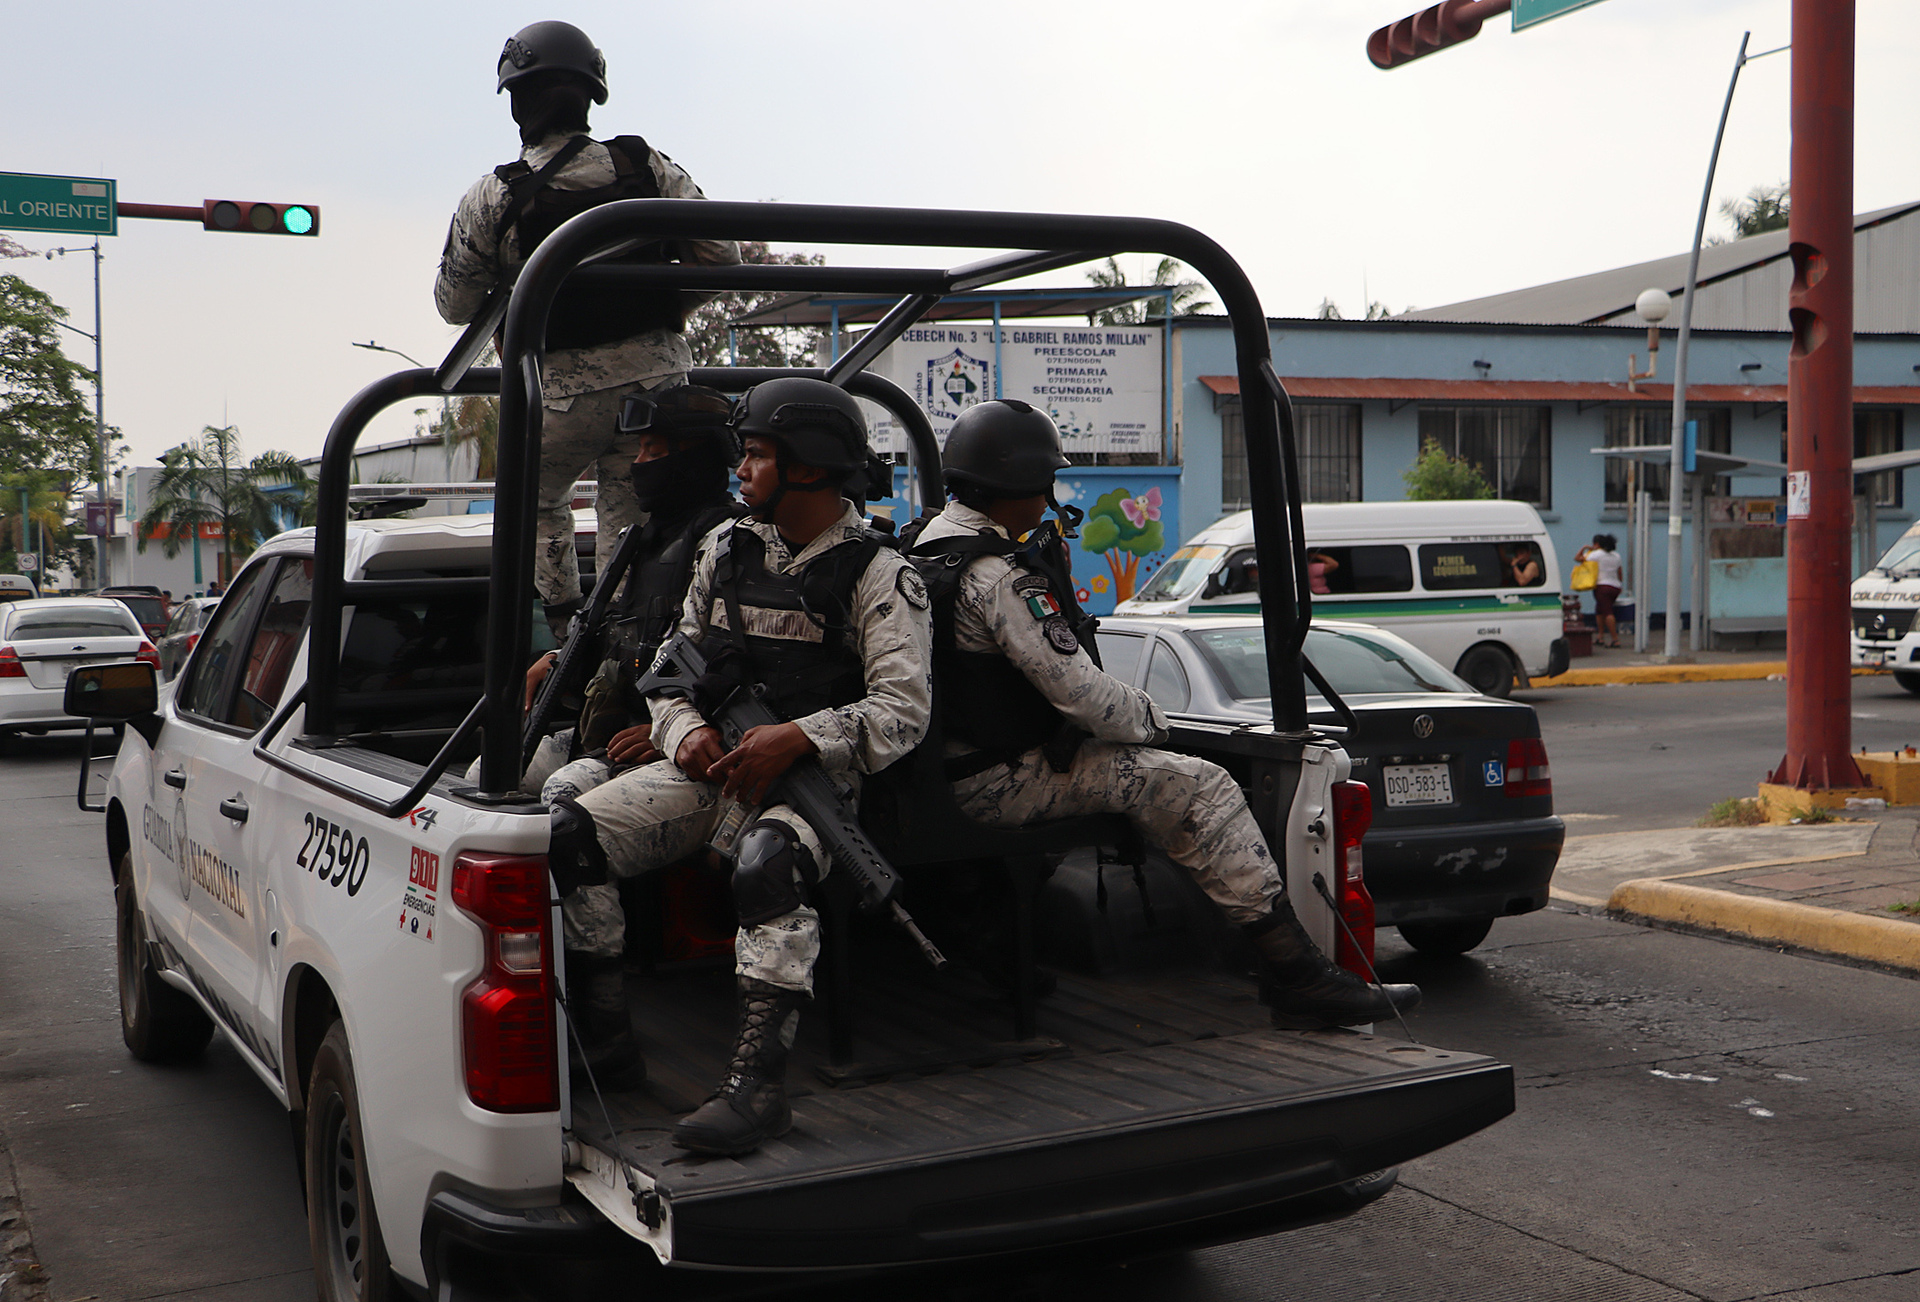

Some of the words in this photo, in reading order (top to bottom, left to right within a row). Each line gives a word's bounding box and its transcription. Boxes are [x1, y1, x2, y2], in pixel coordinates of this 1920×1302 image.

[19, 201, 107, 220] ORIENTE
[902, 330, 945, 342] CEBECH
[949, 330, 967, 343] No.
[971, 331, 977, 343] 3
[1013, 331, 1059, 344] GABRIEL
[1063, 332, 1103, 345] RAMOS
[1034, 347, 1116, 357] PREESCOLAR
[1046, 367, 1108, 376] PRIMARIA
[1032, 386, 1114, 395] SECUNDARIA
[1437, 555, 1465, 566] PEMEX
[1387, 774, 1449, 795] DSD-583-E
[1404, 791, 1436, 799] CHIAPAS
[296, 811, 370, 898] 27590
[411, 852, 438, 886] 911
[189, 838, 245, 919] NACIONAL
[403, 893, 435, 917] EMERGENCIAS
